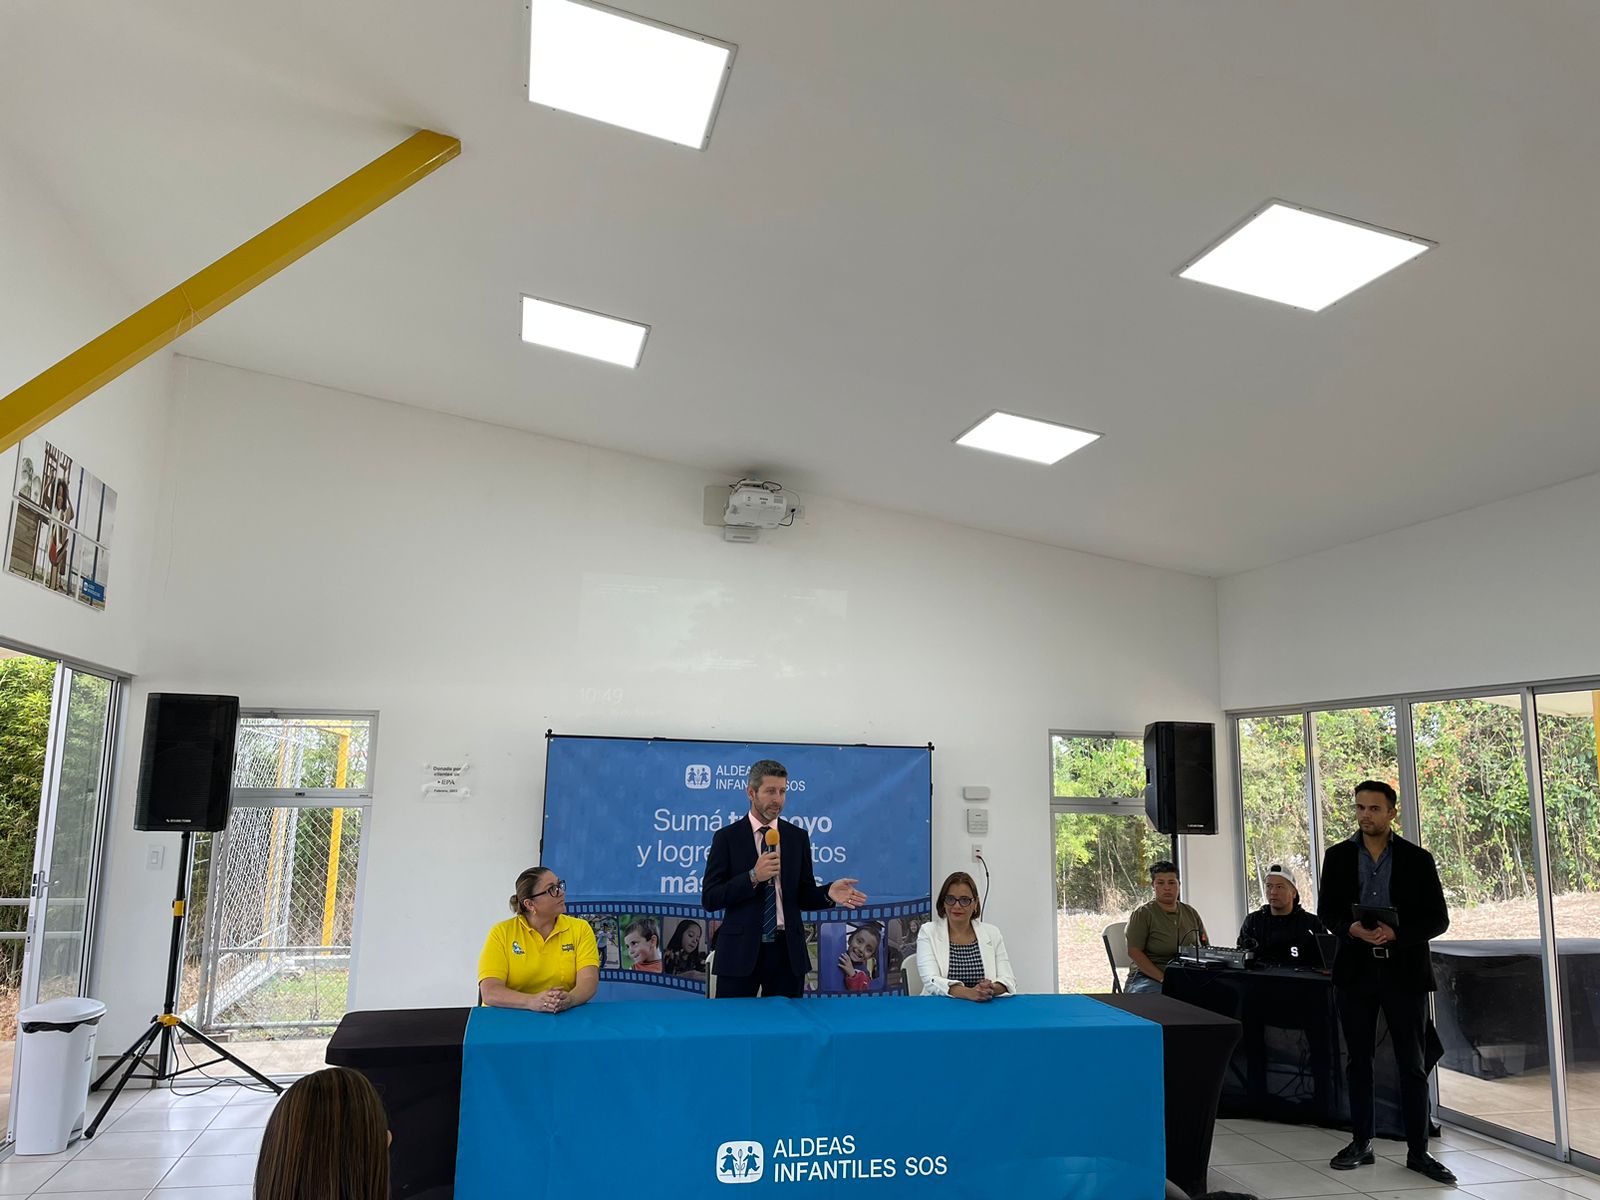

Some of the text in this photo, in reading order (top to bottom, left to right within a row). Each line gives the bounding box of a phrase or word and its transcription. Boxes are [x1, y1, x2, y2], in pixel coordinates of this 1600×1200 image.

[715, 764, 752, 776] ALDEA
[653, 808, 723, 832] Sumá
[636, 844, 652, 868] y
[1290, 946, 1299, 958] S
[772, 1134, 857, 1159] ALDEAS
[773, 1155, 948, 1183] INFANTILES SOS
